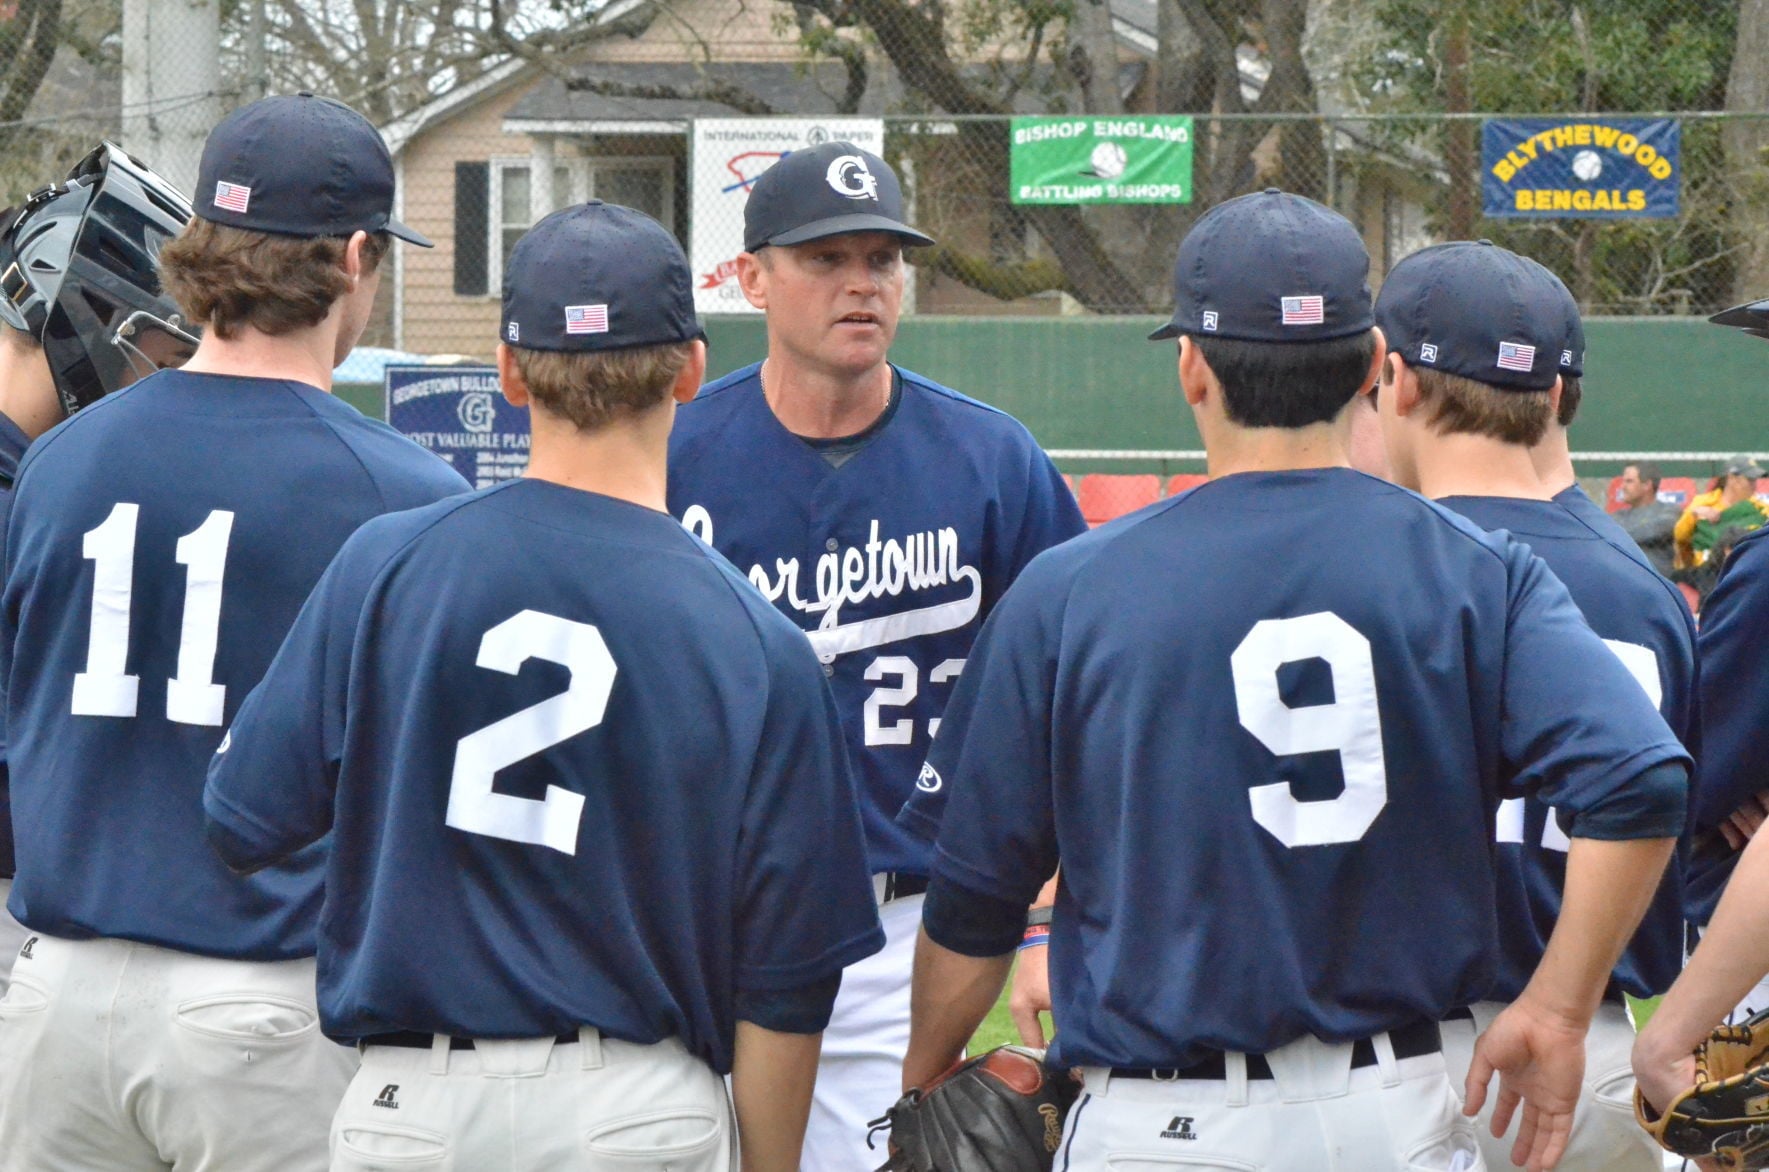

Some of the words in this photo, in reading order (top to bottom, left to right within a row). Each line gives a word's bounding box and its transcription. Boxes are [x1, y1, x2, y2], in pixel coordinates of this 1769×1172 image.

[704, 130, 800, 142] INTERNATIONAL
[1015, 121, 1087, 144] BISHOP
[1093, 121, 1188, 143] ENGLAND
[1491, 124, 1672, 183] BLYTHEWOOD
[826, 155, 879, 201] G
[1020, 184, 1103, 199] BATTLING
[1107, 183, 1182, 199] BISHOPS
[1514, 189, 1647, 210] BENGALS
[437, 432, 500, 448] VALUABLE
[71, 502, 235, 726] 11
[445, 609, 618, 857] 2
[1230, 611, 1388, 849] 9
[1159, 1130, 1198, 1141] RUSSELL
